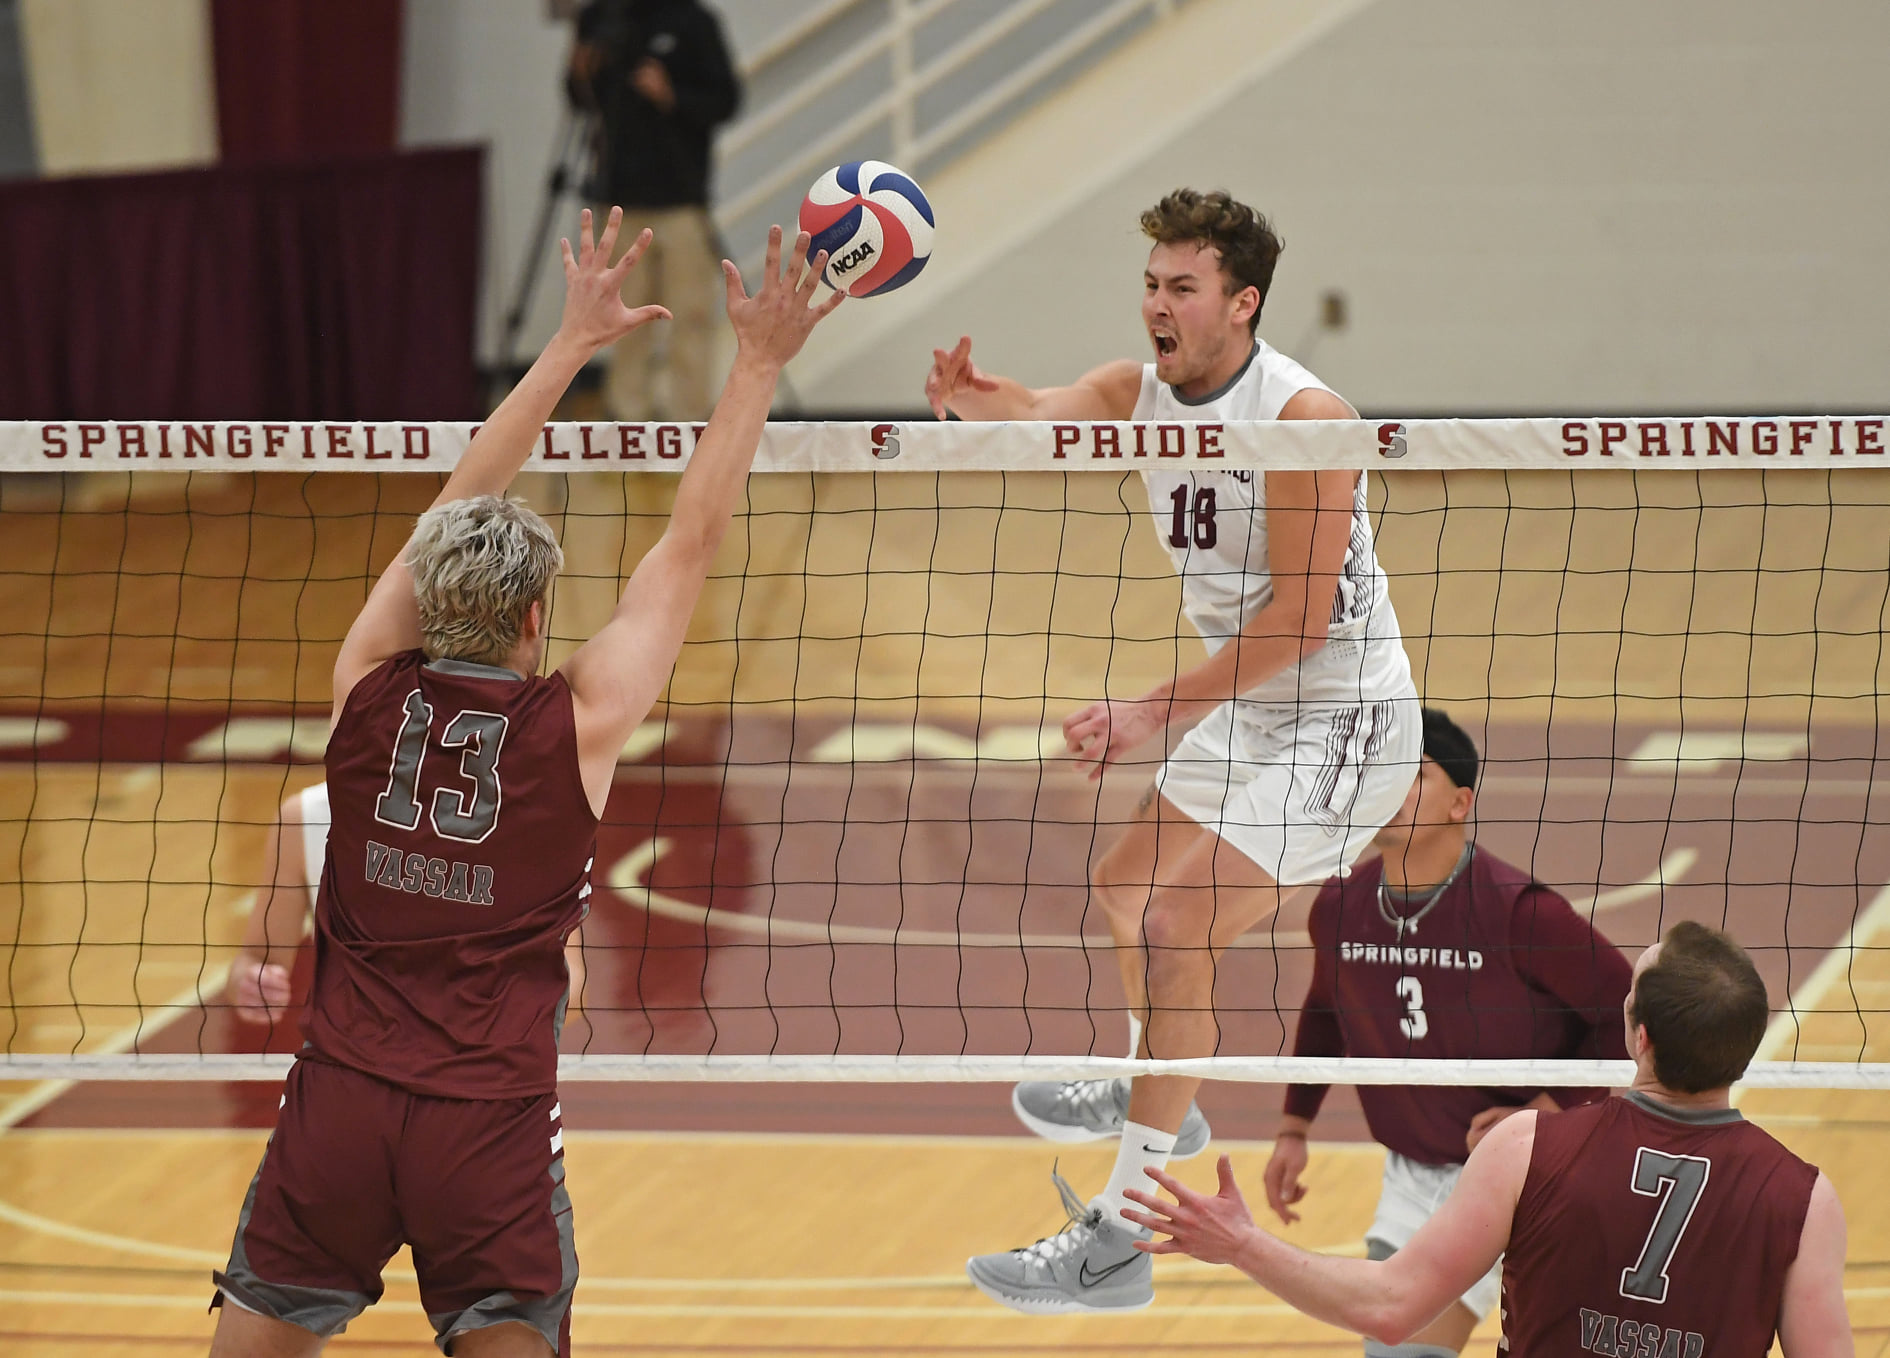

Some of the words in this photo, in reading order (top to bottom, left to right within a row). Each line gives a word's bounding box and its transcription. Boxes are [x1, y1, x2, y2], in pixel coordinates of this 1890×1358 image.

[831, 241, 875, 276] NCAA
[42, 424, 430, 460] SPRINGFIELD
[470, 425, 707, 460] LLEG
[871, 424, 900, 460] S
[1052, 424, 1225, 459] PRIDE
[1377, 423, 1408, 459] S
[1562, 420, 1885, 457] SPRINGFIE
[1168, 483, 1217, 550] 18
[374, 688, 509, 844] 13
[365, 840, 494, 905] VASSAR
[1340, 941, 1484, 971] SPRINGFIELD
[1395, 976, 1429, 1040] 3
[1618, 1146, 1712, 1304] 7
